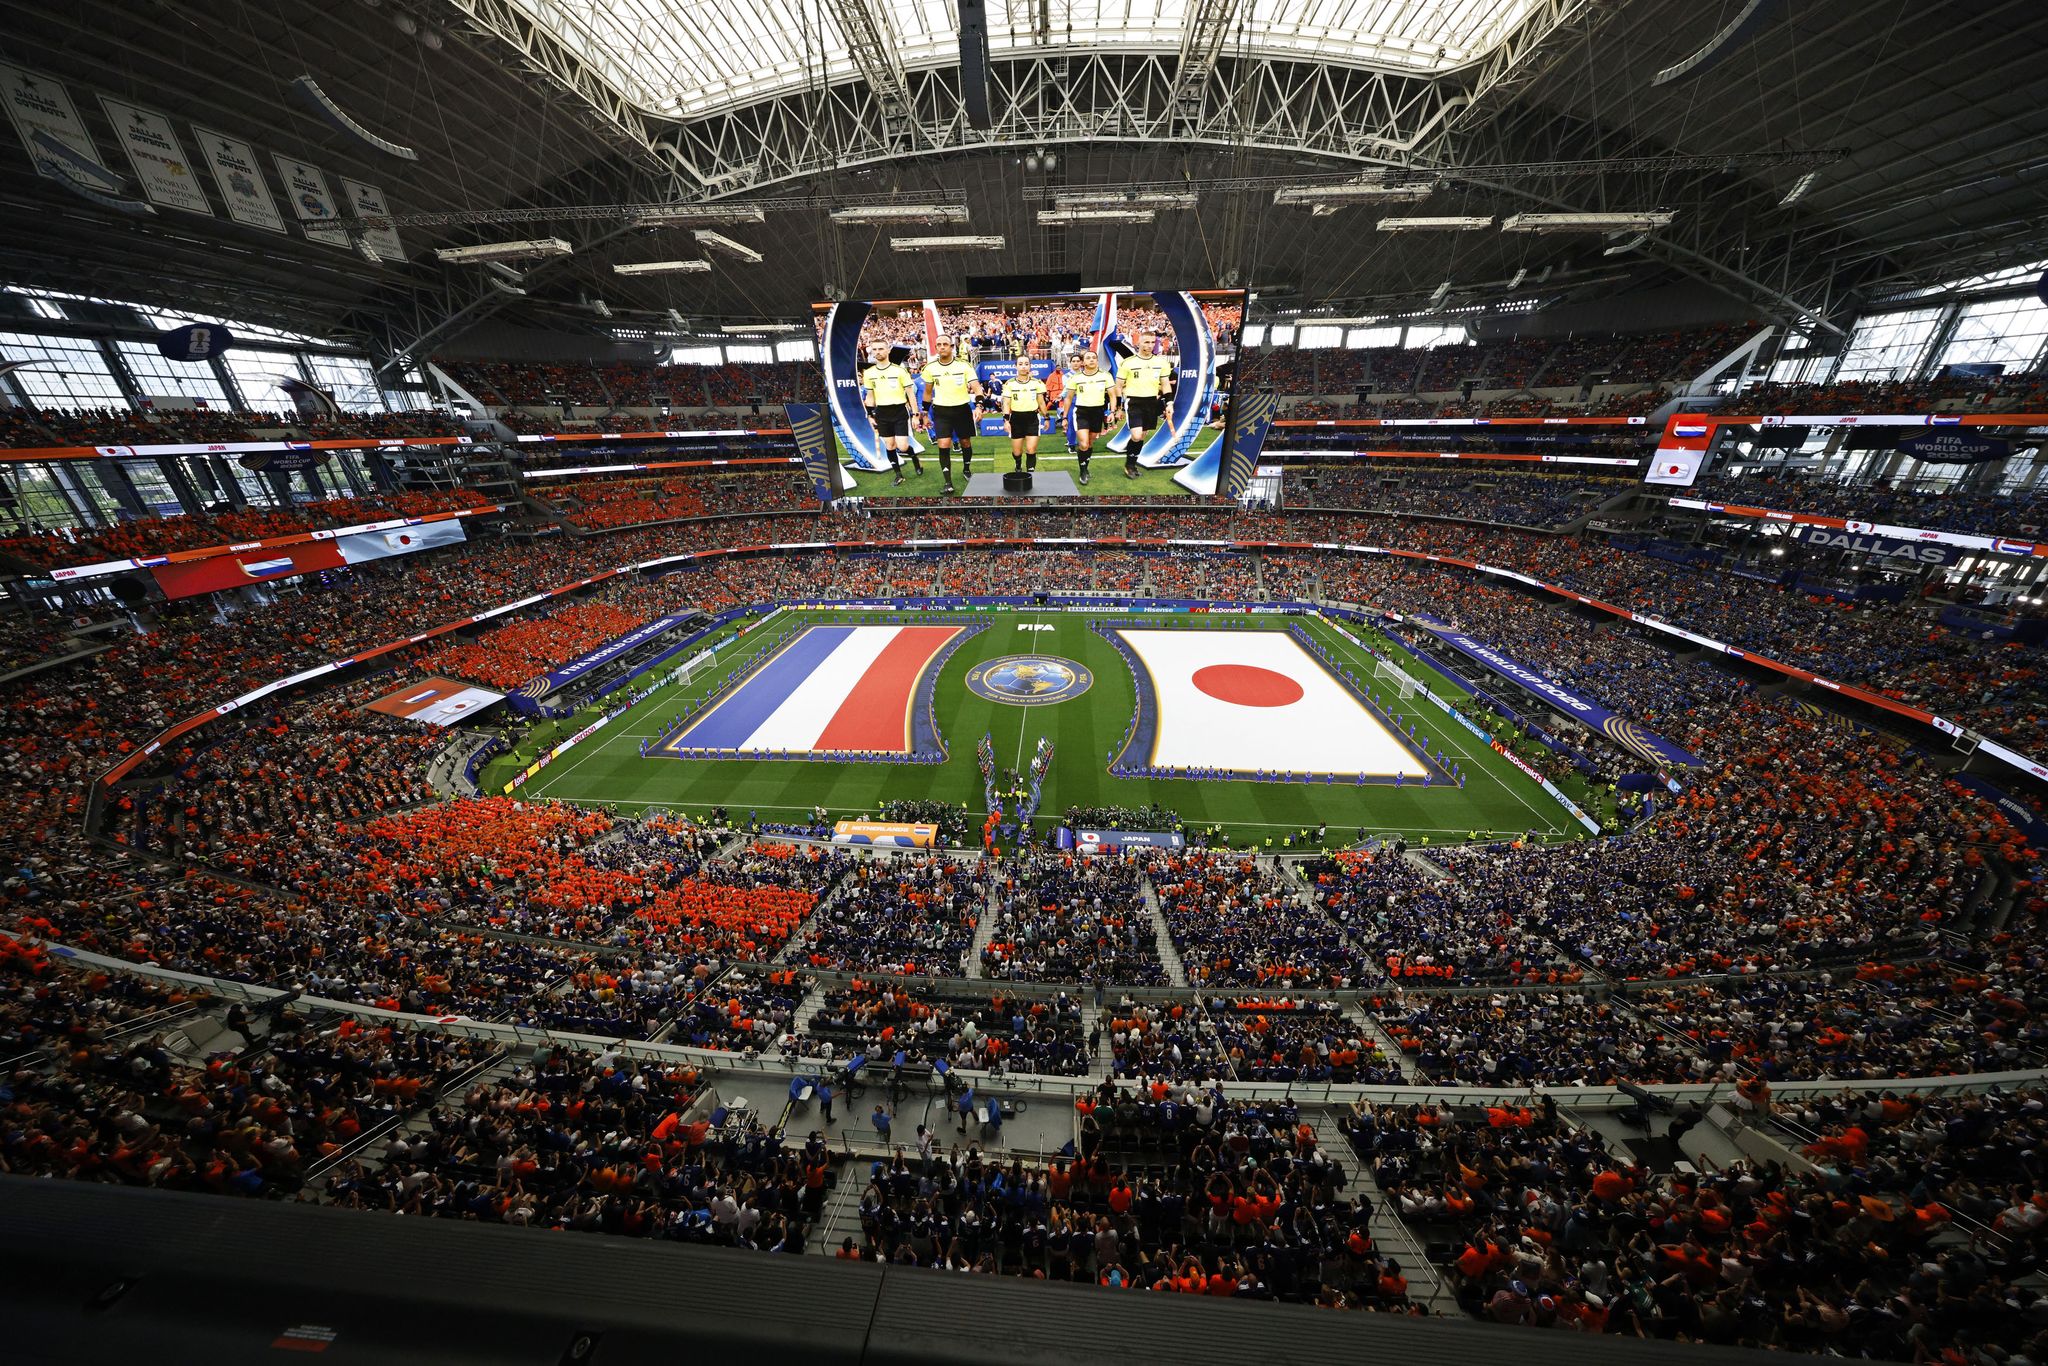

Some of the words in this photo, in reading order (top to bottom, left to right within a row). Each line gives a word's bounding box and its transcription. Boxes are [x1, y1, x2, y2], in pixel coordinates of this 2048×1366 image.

[14, 88, 58, 108] DALLAS
[15, 97, 67, 119] COWBOYS
[129, 125, 163, 141] DALLAS
[129, 133, 171, 150] COWBOYS
[216, 151, 246, 166] DALLAS
[217, 159, 252, 175] COWBOYS
[153, 175, 189, 191] WORLD
[293, 176, 318, 188] DALLAS
[293, 182, 323, 195] COWBOYS
[148, 183, 203, 203] CHAMPIONS
[236, 197, 267, 211] WORLD
[231, 203, 278, 221] CHAMPIONS
[1181, 370, 1197, 378] FIFA
[836, 380, 856, 388] FIFA
[1935, 436, 1962, 445] FIFA
[1914, 443, 1958, 453] WORLD
[1960, 445, 1990, 453] CUP
[1926, 452, 1973, 460] 2026
[1765, 512, 1793, 520] NETHERLANDS
[1919, 532, 1939, 540] JAPAN
[229, 542, 262, 551] NETHERLANDS
[1808, 531, 1947, 564] DALLAS
[55, 570, 77, 578] JAPAN
[558, 661, 591, 675] FIFA
[583, 643, 626, 662] WORLD
[622, 633, 643, 644] CUP
[641, 619, 675, 634] 2026
[1454, 637, 1480, 649] FIFA
[1475, 648, 1518, 670] WORLD
[1511, 669, 1543, 684] CUP
[1535, 683, 1593, 711] 2026
[1813, 677, 1841, 690] NETHERLANDS
[630, 691, 649, 705] ULTRA
[1454, 711, 1484, 740] Hisense
[571, 725, 597, 744] verizon
[1541, 734, 1553, 744] FIFA
[1503, 749, 1544, 783] McDonald's
[2031, 766, 2048, 776] JAPAN
[1554, 792, 1573, 809] Dove
[851, 825, 909, 833] NETHERLANDS
[1166, 1108, 1173, 1119] 8
